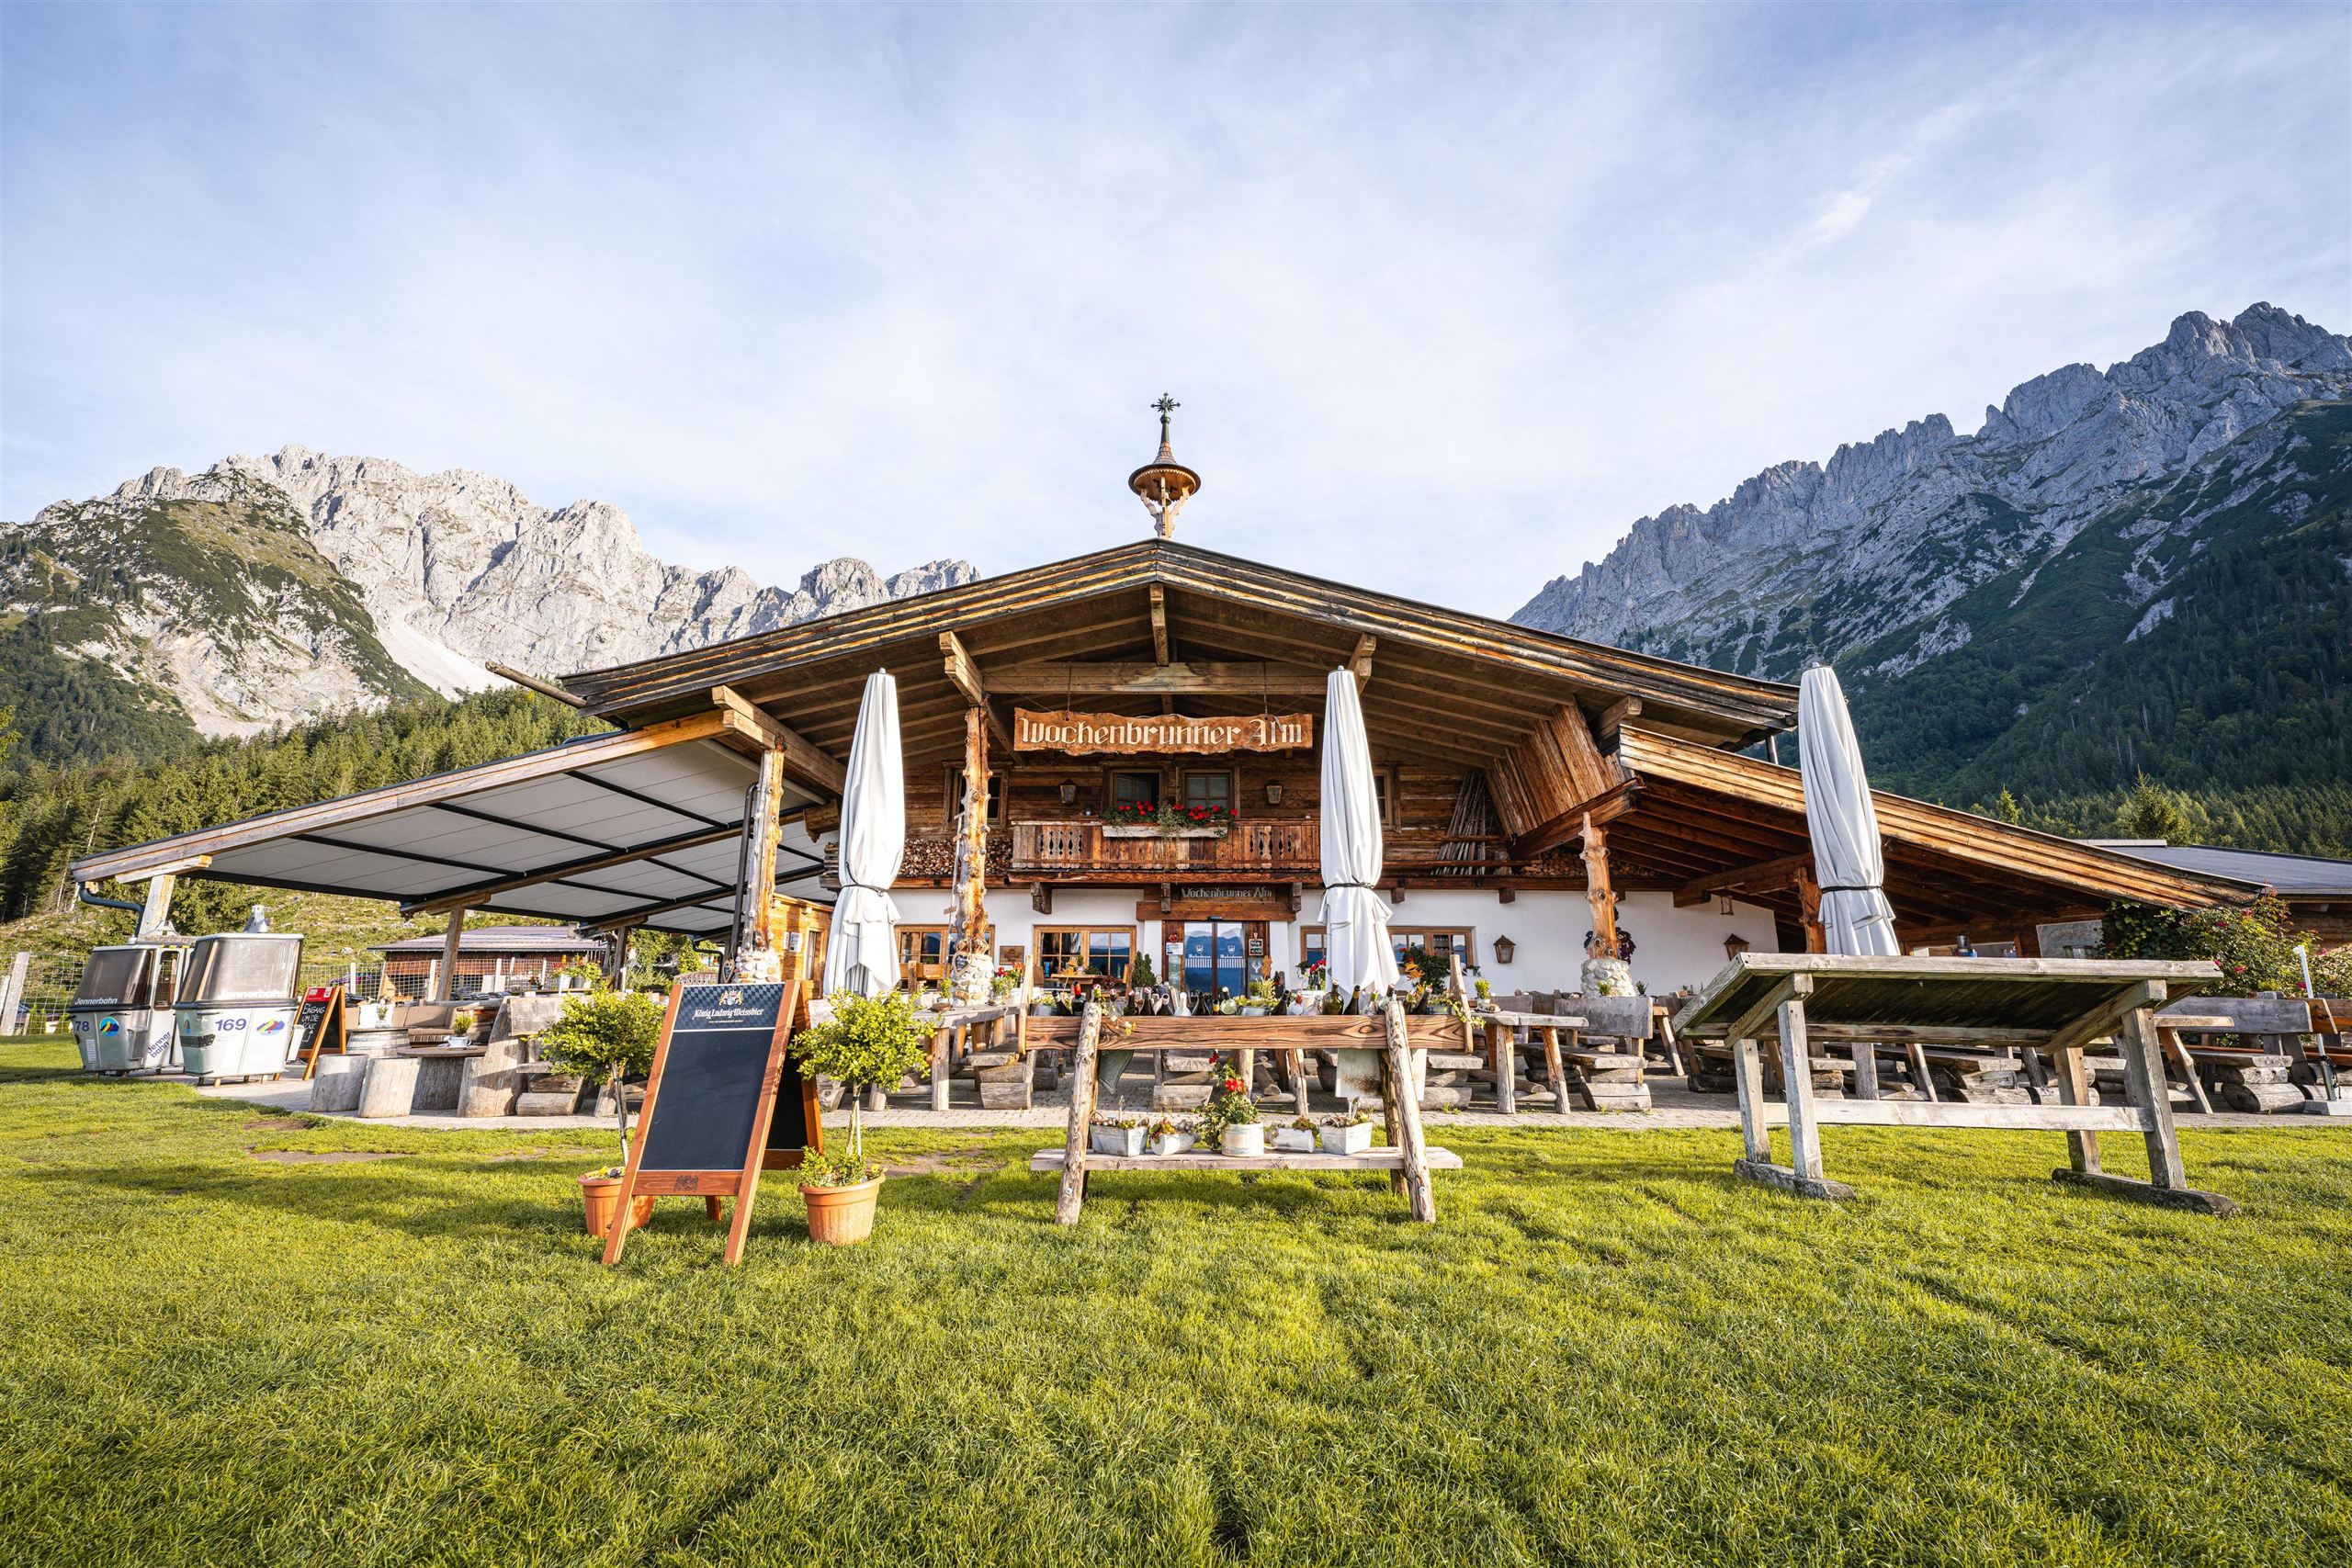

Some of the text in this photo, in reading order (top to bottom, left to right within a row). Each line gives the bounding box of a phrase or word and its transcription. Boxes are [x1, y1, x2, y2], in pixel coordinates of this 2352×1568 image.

[1019, 717, 1303, 746] Wochenbrunner Alm
[1181, 886, 1272, 897] Wochenbrunner Alm
[692, 1007, 763, 1020] König Ludwig Weissbier
[75, 1021, 90, 1032] 78
[215, 1018, 247, 1032] 169
[147, 1031, 171, 1054] Jenner
[150, 1042, 170, 1058] bahn
